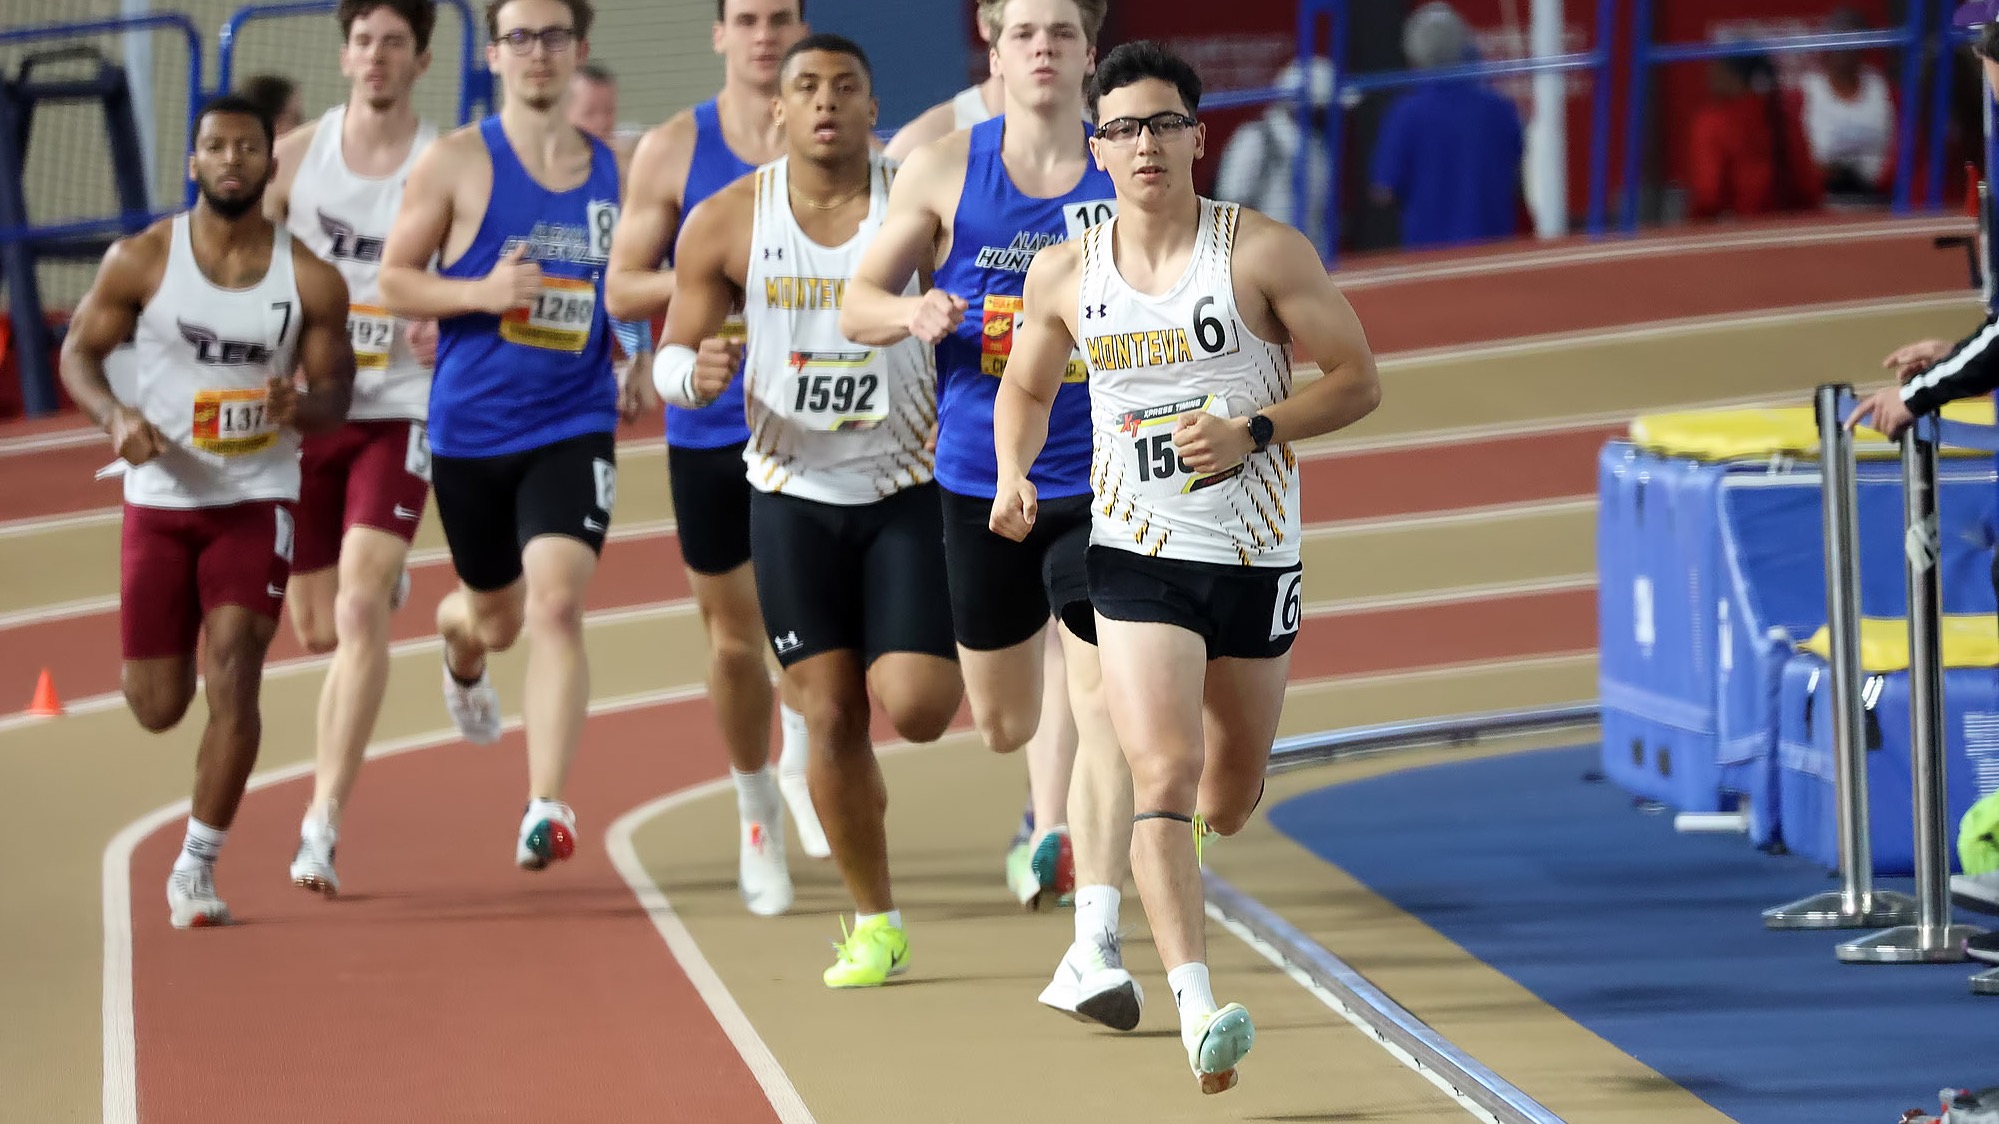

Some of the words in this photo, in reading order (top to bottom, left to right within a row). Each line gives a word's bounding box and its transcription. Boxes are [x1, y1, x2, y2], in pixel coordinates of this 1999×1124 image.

[597, 208, 614, 251] 8
[1076, 203, 1112, 230] 10
[272, 301, 291, 347] 7
[1193, 296, 1226, 353] 6
[794, 374, 878, 412] 1592
[1143, 404, 1173, 419] XPRESS
[1175, 398, 1201, 412] TIMING
[1282, 574, 1301, 631] 6
